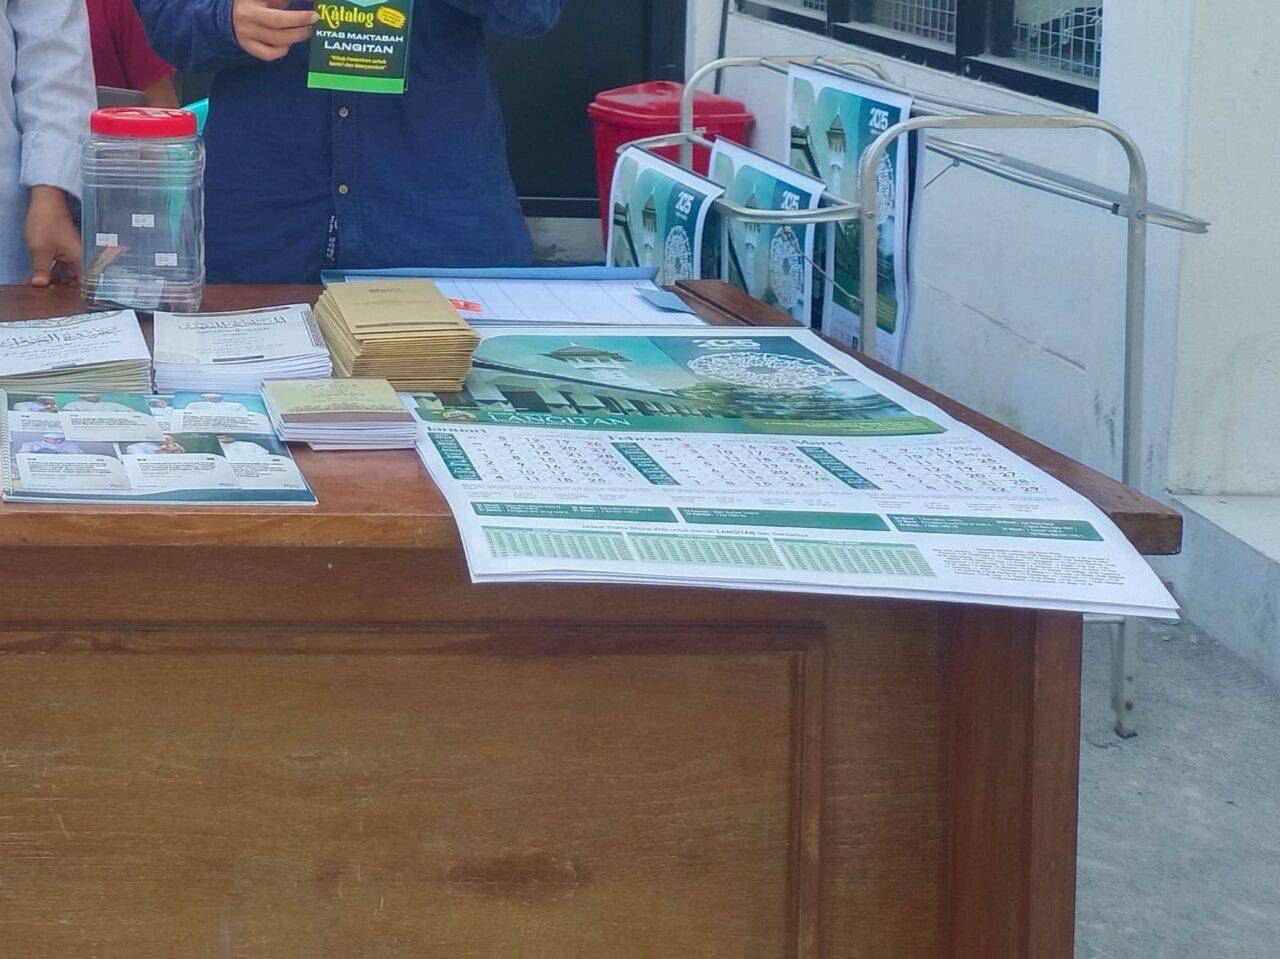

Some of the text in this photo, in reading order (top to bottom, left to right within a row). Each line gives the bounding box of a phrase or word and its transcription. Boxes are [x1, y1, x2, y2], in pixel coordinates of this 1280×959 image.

[318, 4, 375, 29] Katalog
[315, 29, 405, 43] KITAB MAKTABAH
[323, 40, 395, 54] LANGITAN
[487, 411, 632, 427] LANGITAN
